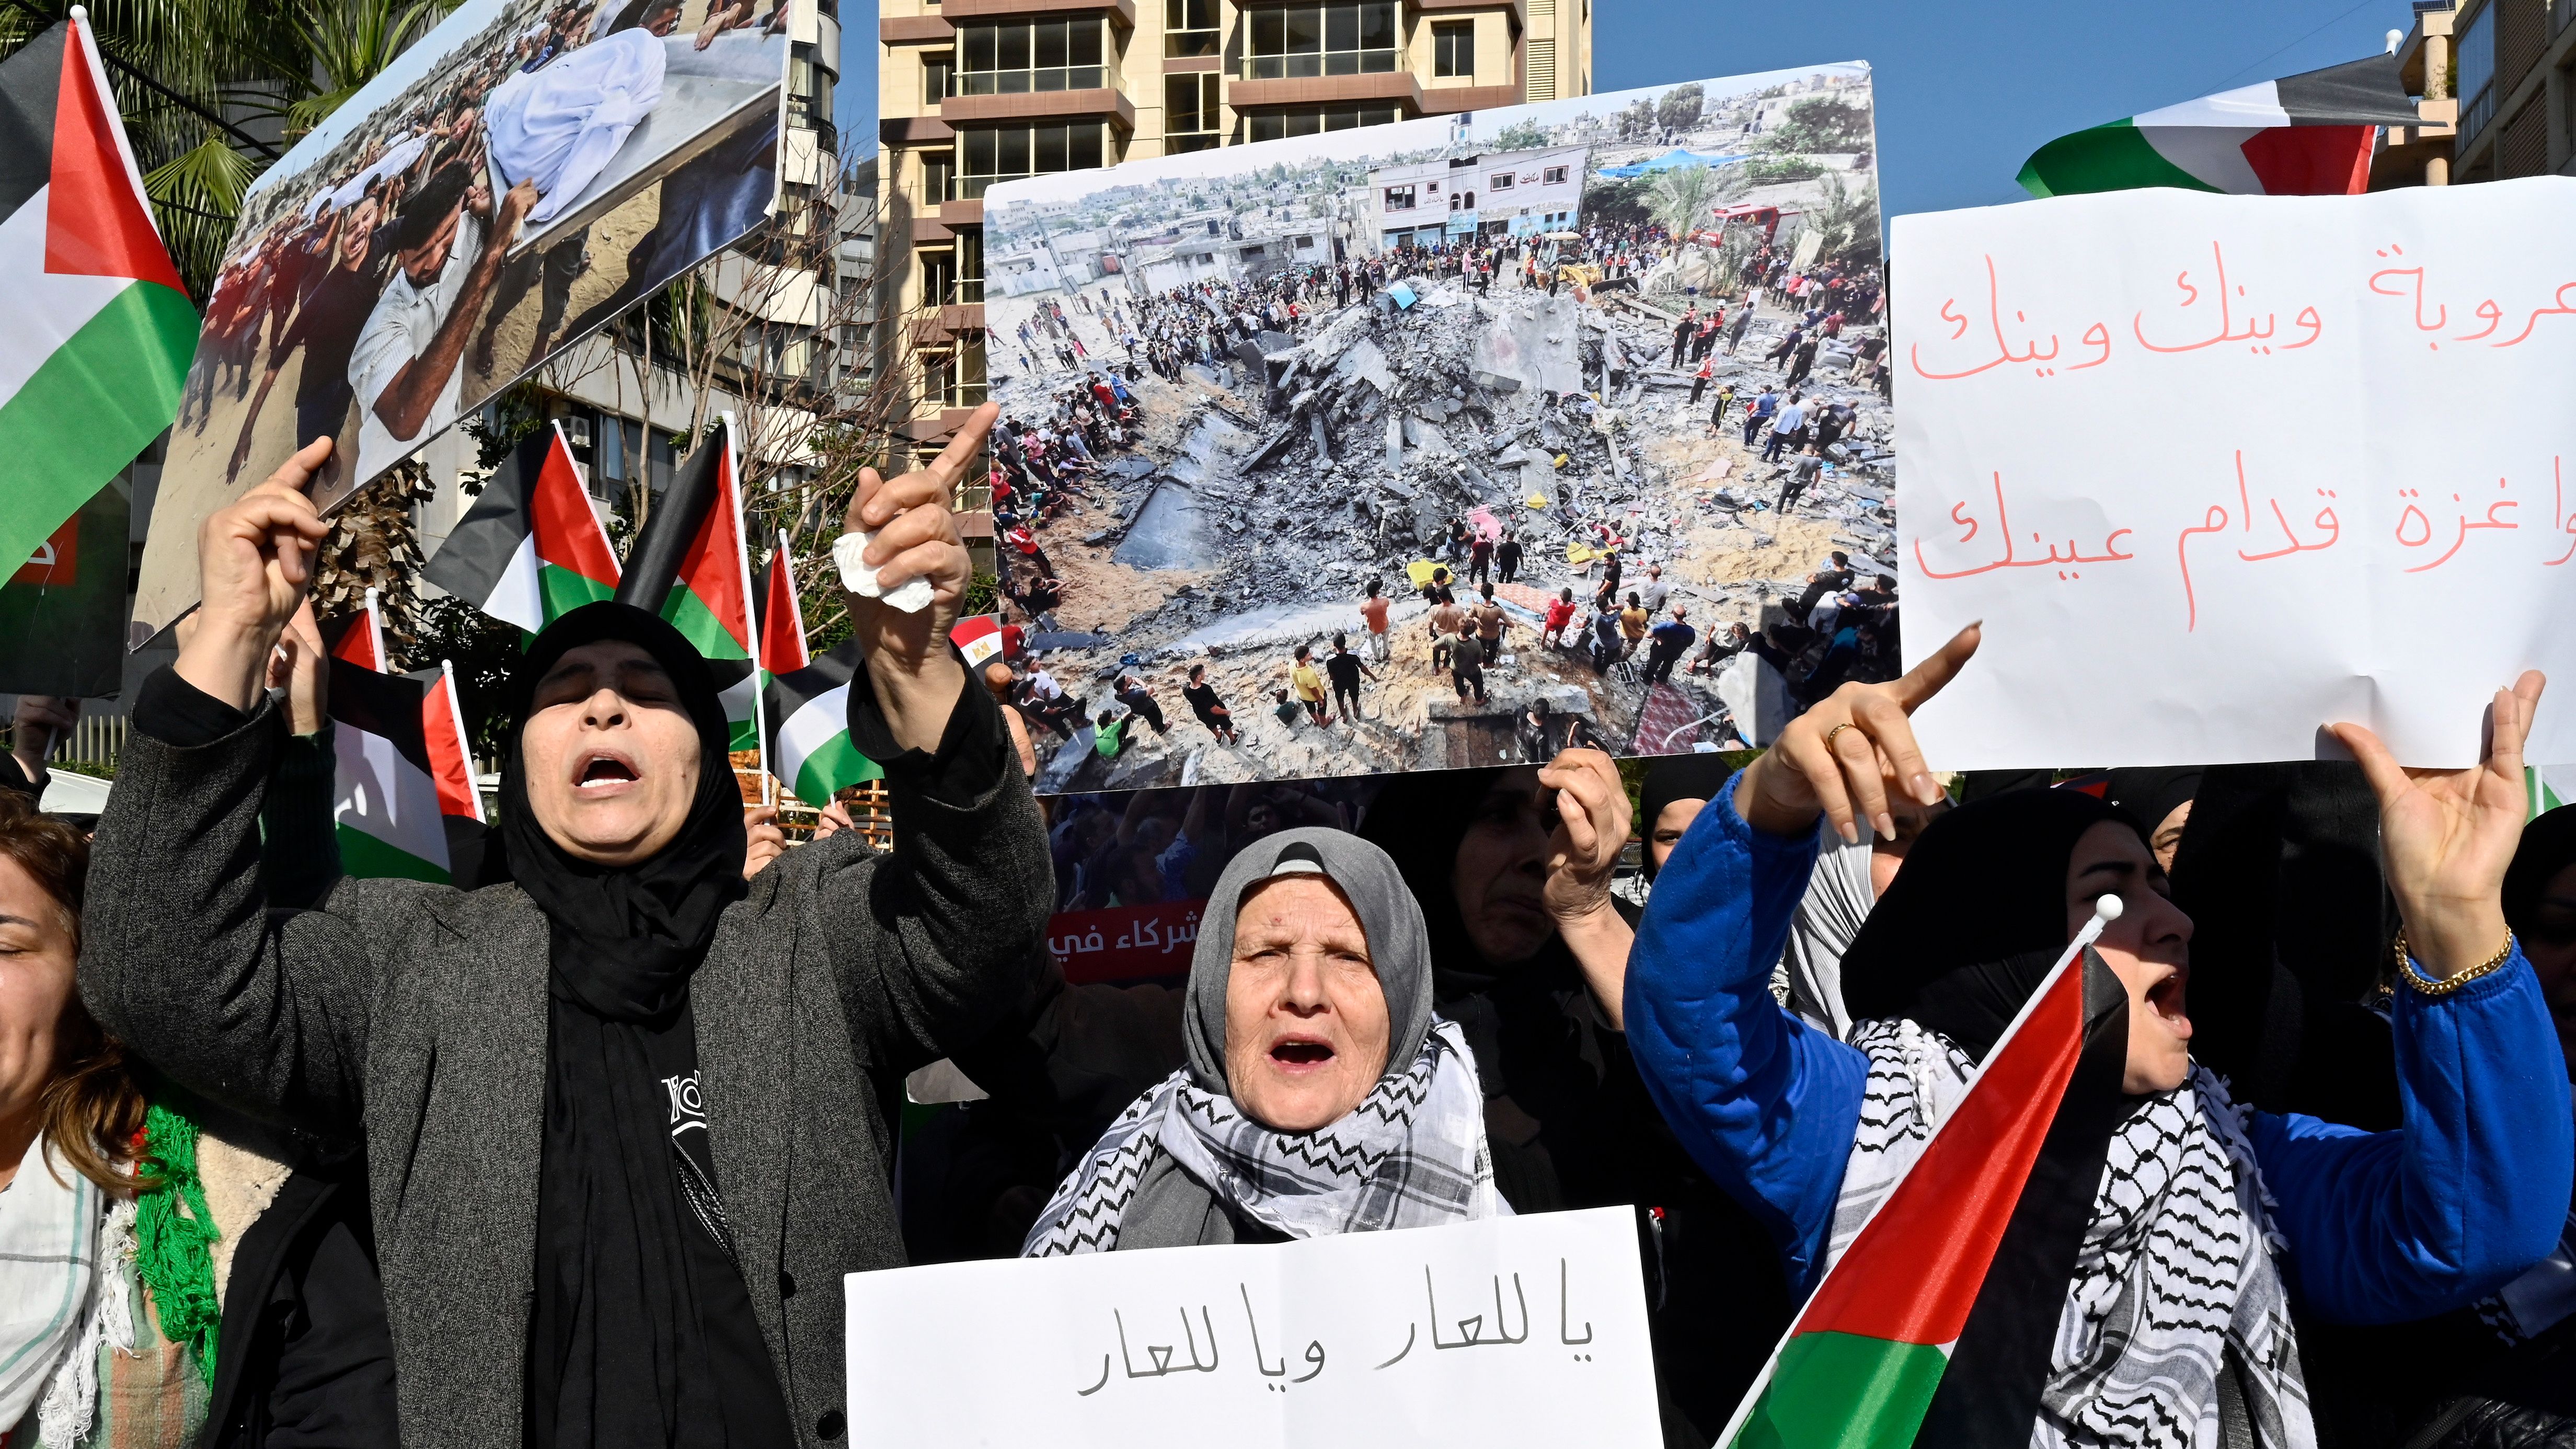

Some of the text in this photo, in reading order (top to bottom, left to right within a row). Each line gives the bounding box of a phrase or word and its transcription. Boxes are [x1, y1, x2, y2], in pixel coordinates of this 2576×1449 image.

[1912, 255, 2110, 380] وينك
[2134, 240, 2322, 355] وينك
[1915, 471, 2134, 580] عينك
[2178, 449, 2339, 632] قدام
[2395, 477, 2518, 573] غزة
[1048, 925, 1104, 962] في
[1077, 1258, 1593, 1397] يا للعار ويا للعار
